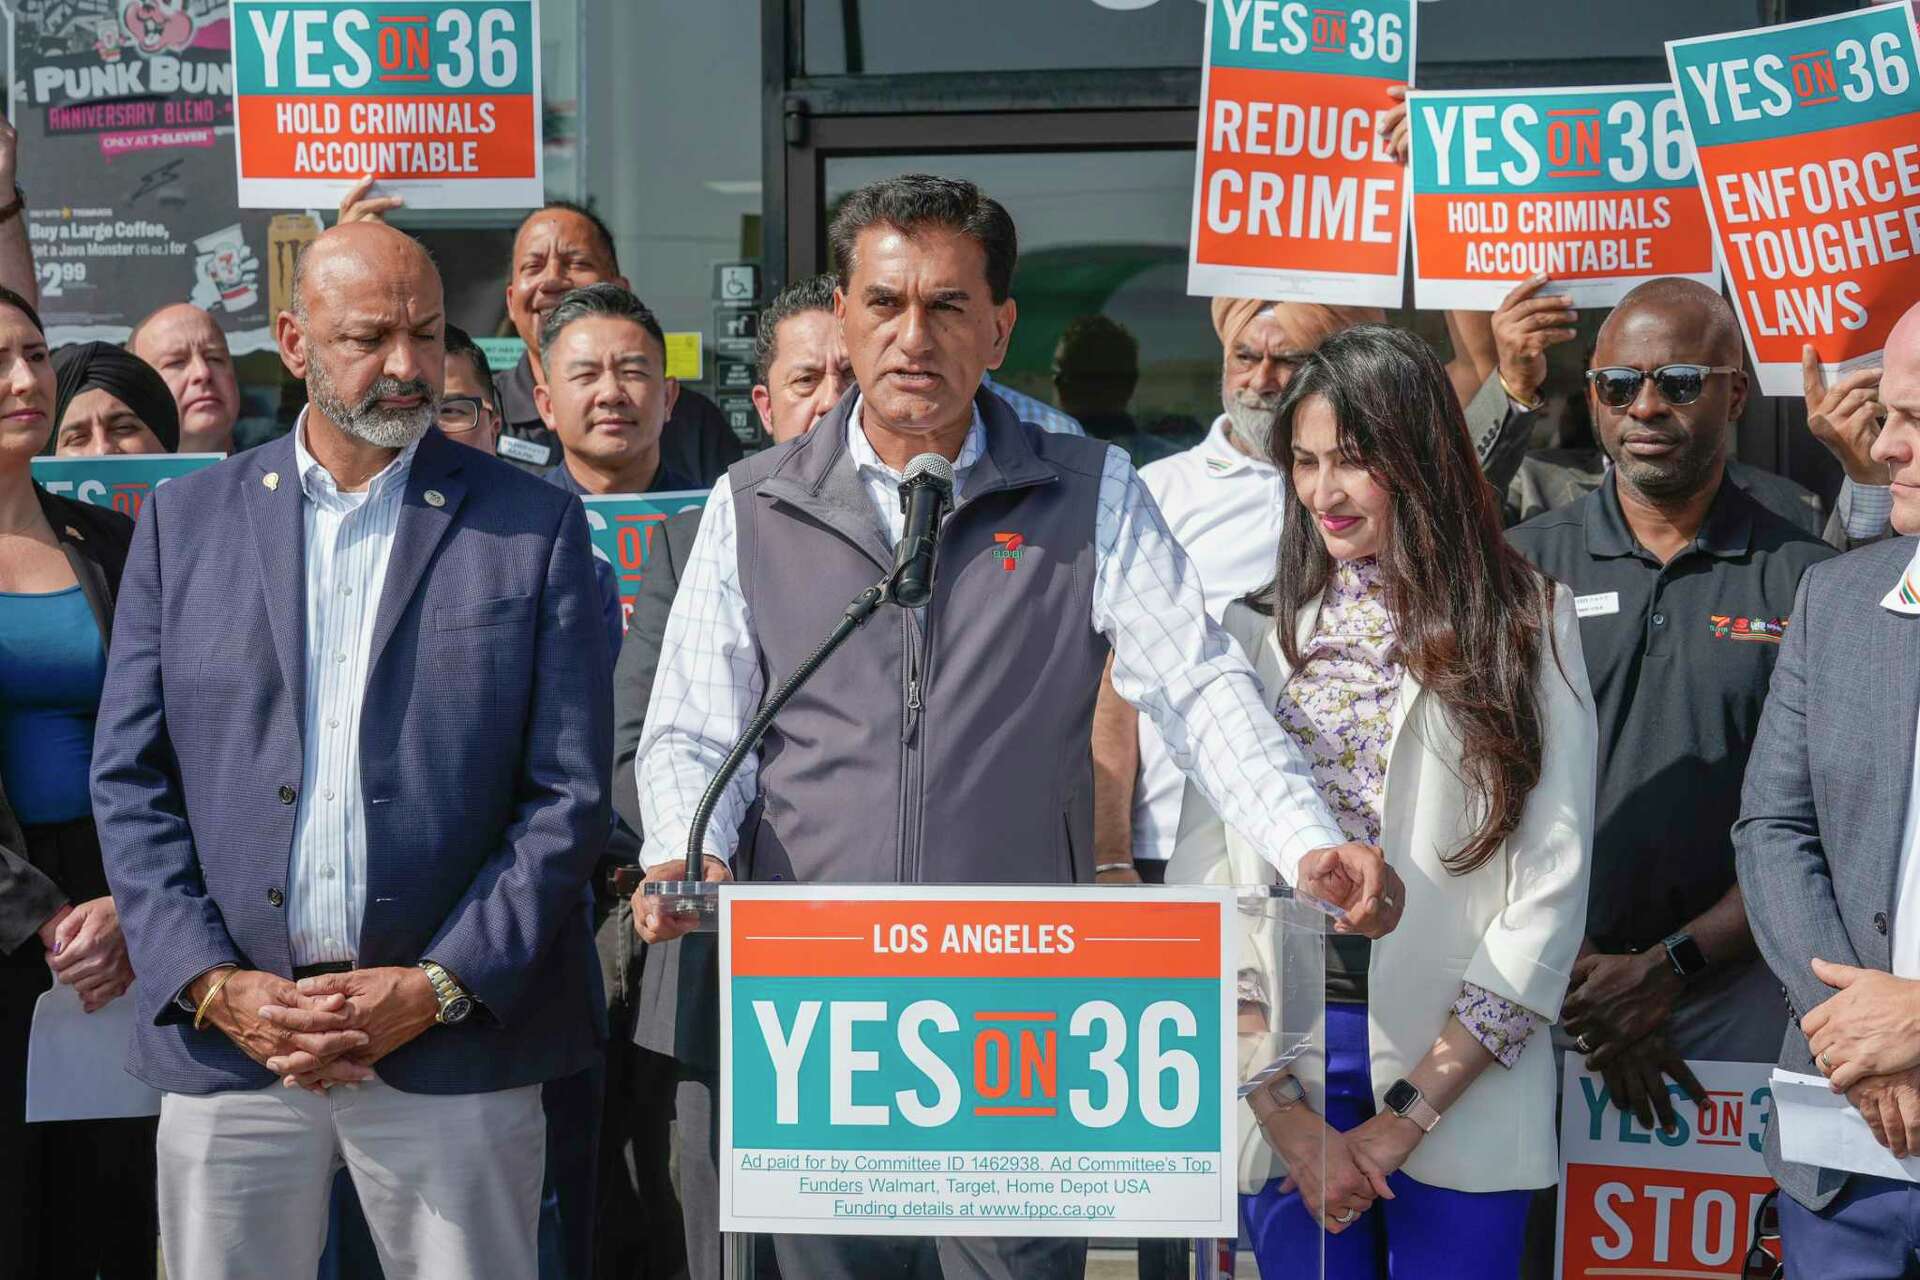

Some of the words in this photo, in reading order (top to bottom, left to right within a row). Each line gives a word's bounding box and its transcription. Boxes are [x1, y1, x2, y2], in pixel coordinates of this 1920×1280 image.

[249, 9, 372, 89] YES
[378, 26, 430, 70] ON
[436, 8, 518, 89] 36
[1222, 0, 1309, 56] YES
[1311, 16, 1347, 46] ON
[1350, 9, 1403, 64] 36
[33, 60, 145, 102] PUNK
[1686, 53, 1793, 125] YES
[1791, 58, 1838, 98] ON
[1836, 32, 1910, 103] 36
[49, 103, 157, 129] ANNIVERSARY
[165, 98, 213, 124] BLEND
[276, 103, 340, 134] HOLD
[350, 102, 497, 134] CRIMINALS
[103, 136, 133, 148] ONLY
[134, 135, 149, 146] AT
[294, 141, 480, 173] ACCOUNTABLE
[1422, 103, 1541, 186] YES
[1547, 120, 1600, 167] ON
[1607, 98, 1694, 184] 36
[1716, 144, 1920, 224] ENFORCE
[1207, 168, 1396, 244] CRIME
[1447, 201, 1509, 233] HOLD
[1518, 196, 1672, 233] CRIMINALS
[29, 223, 58, 242] Buy
[60, 226, 69, 239] a
[70, 222, 113, 242] Large
[115, 221, 169, 240] Coffee,
[49, 246, 57, 256] a
[59, 243, 85, 257] Java
[87, 242, 134, 257] Monster
[170, 242, 186, 255] for
[1465, 238, 1653, 273] ACCOUNTABLE
[1747, 280, 1869, 337] LAWS
[873, 924, 928, 954] LOS
[939, 924, 1076, 954] ANGELES
[751, 1000, 962, 1127] YES
[973, 1029, 1057, 1099] ON
[1069, 1000, 1200, 1128] 36
[1697, 1099, 1744, 1137] ON
[741, 1154, 762, 1169] Ad
[767, 1155, 800, 1171] paid
[805, 1154, 826, 1169] for
[831, 1155, 849, 1173] by
[855, 1155, 942, 1171] Committee
[947, 1156, 965, 1171] ID
[973, 1156, 1043, 1171] 1462938.
[1050, 1156, 1072, 1171] Ad
[1078, 1156, 1177, 1172] Committee's
[1181, 1157, 1212, 1174] Top
[799, 1177, 863, 1192] Funders
[868, 1178, 940, 1195] Walmart,
[946, 1178, 1000, 1197] Target,
[1006, 1179, 1055, 1194] Home
[1060, 1179, 1110, 1197] Depot
[1114, 1179, 1151, 1194] USA
[834, 1200, 897, 1218] Funding
[902, 1200, 953, 1216] details
[959, 1202, 975, 1216] at
[979, 1201, 1116, 1219] www.fppc.ca.gov
